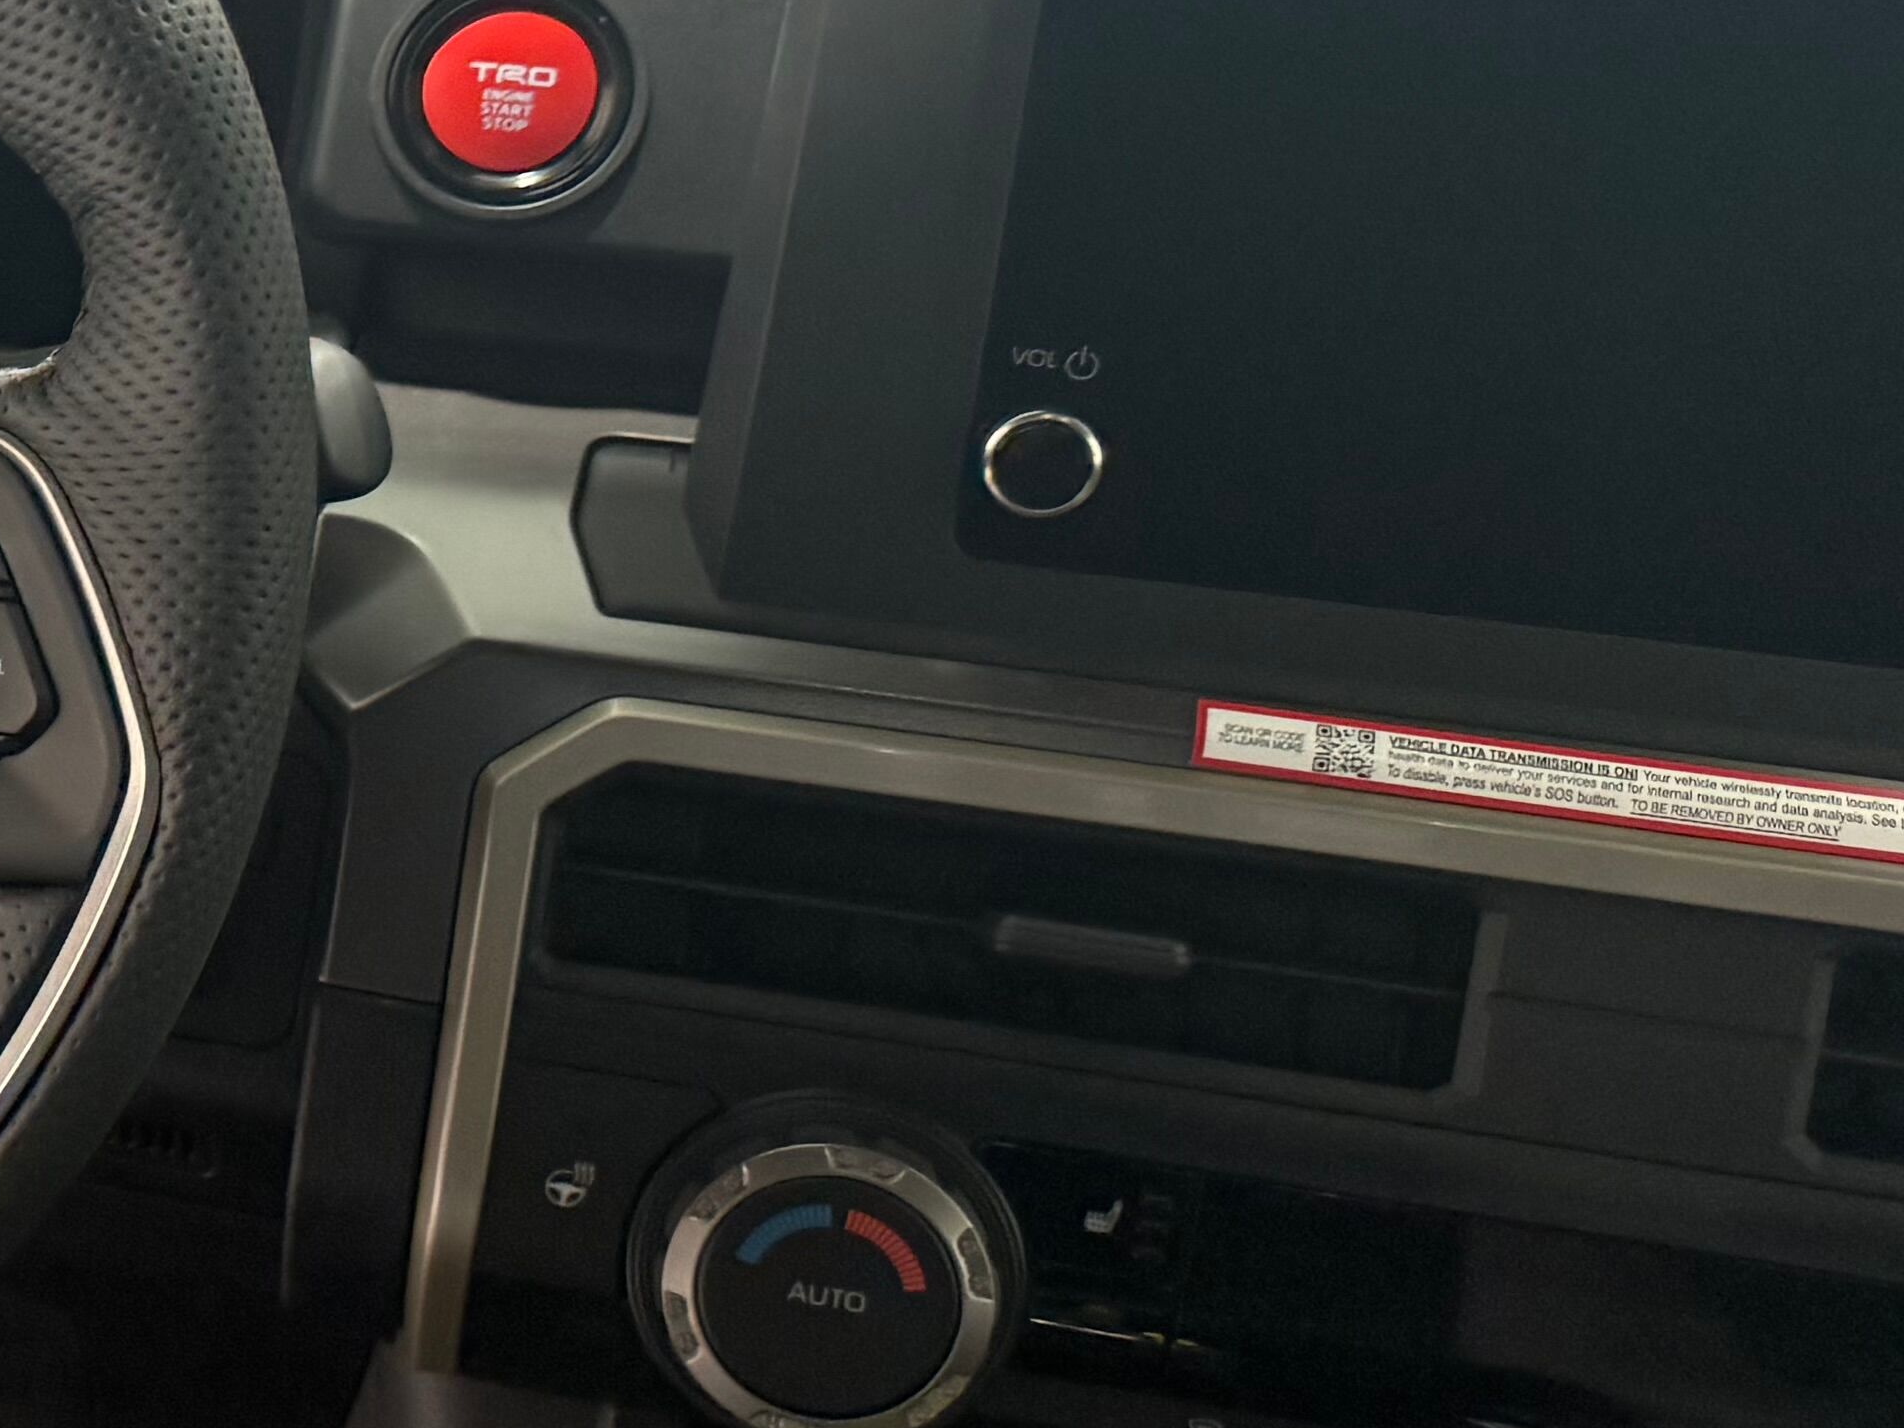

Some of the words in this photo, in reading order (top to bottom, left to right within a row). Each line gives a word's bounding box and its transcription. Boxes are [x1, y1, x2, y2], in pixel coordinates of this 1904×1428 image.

[469, 61, 559, 88] TRD
[480, 102, 534, 117] START
[481, 117, 528, 132] STOP
[1012, 346, 1056, 368] VOL
[1389, 735, 1447, 752] VEHICLE
[1451, 743, 1486, 759] DATA
[1488, 749, 1593, 773] TRANSMISSION
[1644, 770, 1671, 783] Your
[1674, 775, 1717, 790] vehicle
[1721, 782, 1781, 799] wirelessly
[1786, 788, 1842, 806] transmits
[1846, 795, 1899, 815] location,
[1388, 764, 1400, 778] To
[1403, 767, 1449, 786] disable,
[1453, 776, 1485, 790] press
[1490, 779, 1541, 798] vehicle's
[1545, 786, 1574, 802] SOS
[1577, 792, 1619, 808] button.
[1632, 798, 1648, 812] TO
[1651, 801, 1668, 814] BE
[1671, 804, 1734, 824] REMOVED
[1736, 812, 1754, 825] BY
[1756, 816, 1805, 833] OWNER
[1808, 822, 1842, 837] ONLY
[1428, 755, 1453, 767] data
[1459, 760, 1470, 771] to
[1474, 762, 1514, 776] deliver
[1517, 769, 1543, 782] your
[1547, 774, 1596, 788] services
[1601, 780, 1623, 792] and
[1628, 782, 1643, 794] for
[1647, 784, 1692, 801] internal
[1697, 792, 1750, 809] research
[1754, 800, 1777, 813] and
[1782, 802, 1809, 817] data
[1813, 807, 1867, 825] analysis.
[1872, 813, 1897, 829] See
[787, 1280, 866, 1313] AUTO
